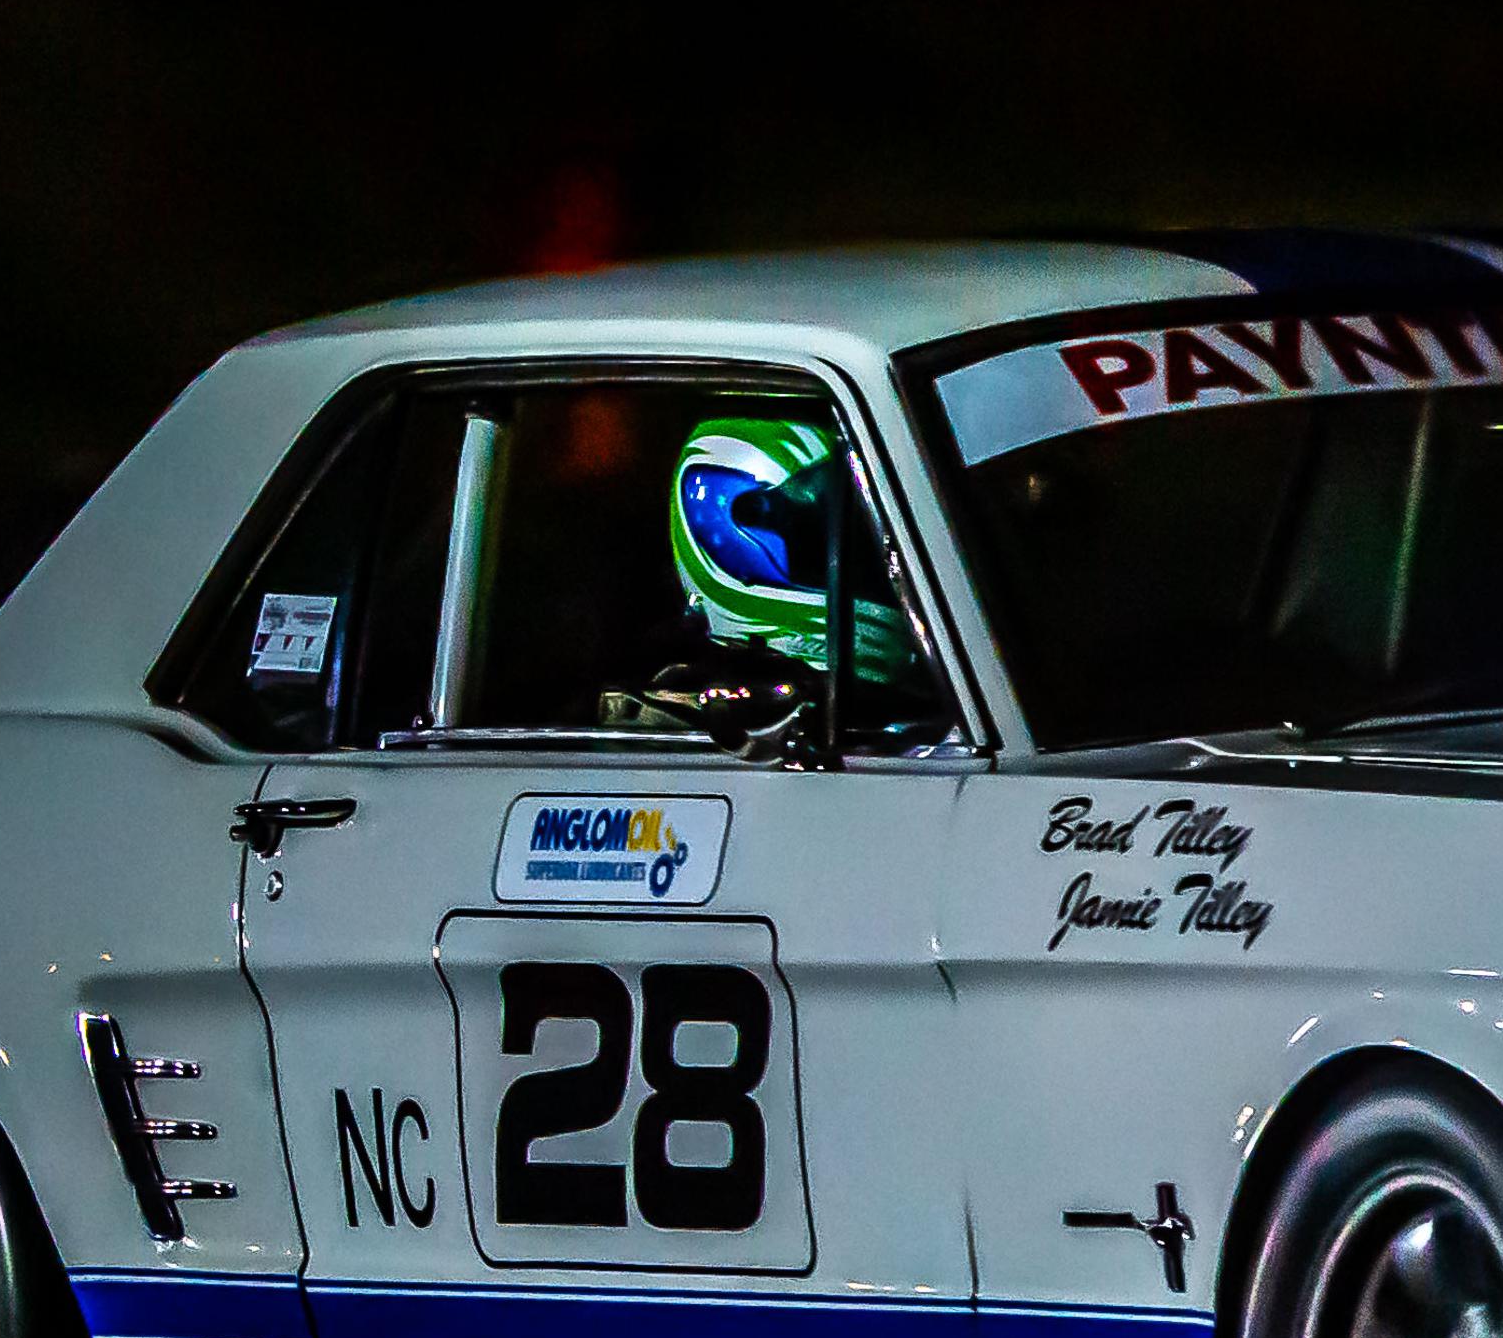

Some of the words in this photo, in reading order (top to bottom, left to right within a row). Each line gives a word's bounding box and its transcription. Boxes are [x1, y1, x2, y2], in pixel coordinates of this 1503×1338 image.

[1040, 796, 1150, 852] Brad
[1153, 798, 1254, 873] Tilley
[1047, 871, 1162, 951] Jamie
[1173, 873, 1274, 951] Tilley
[497, 961, 773, 1232] 28
[335, 1087, 436, 1229] NC
